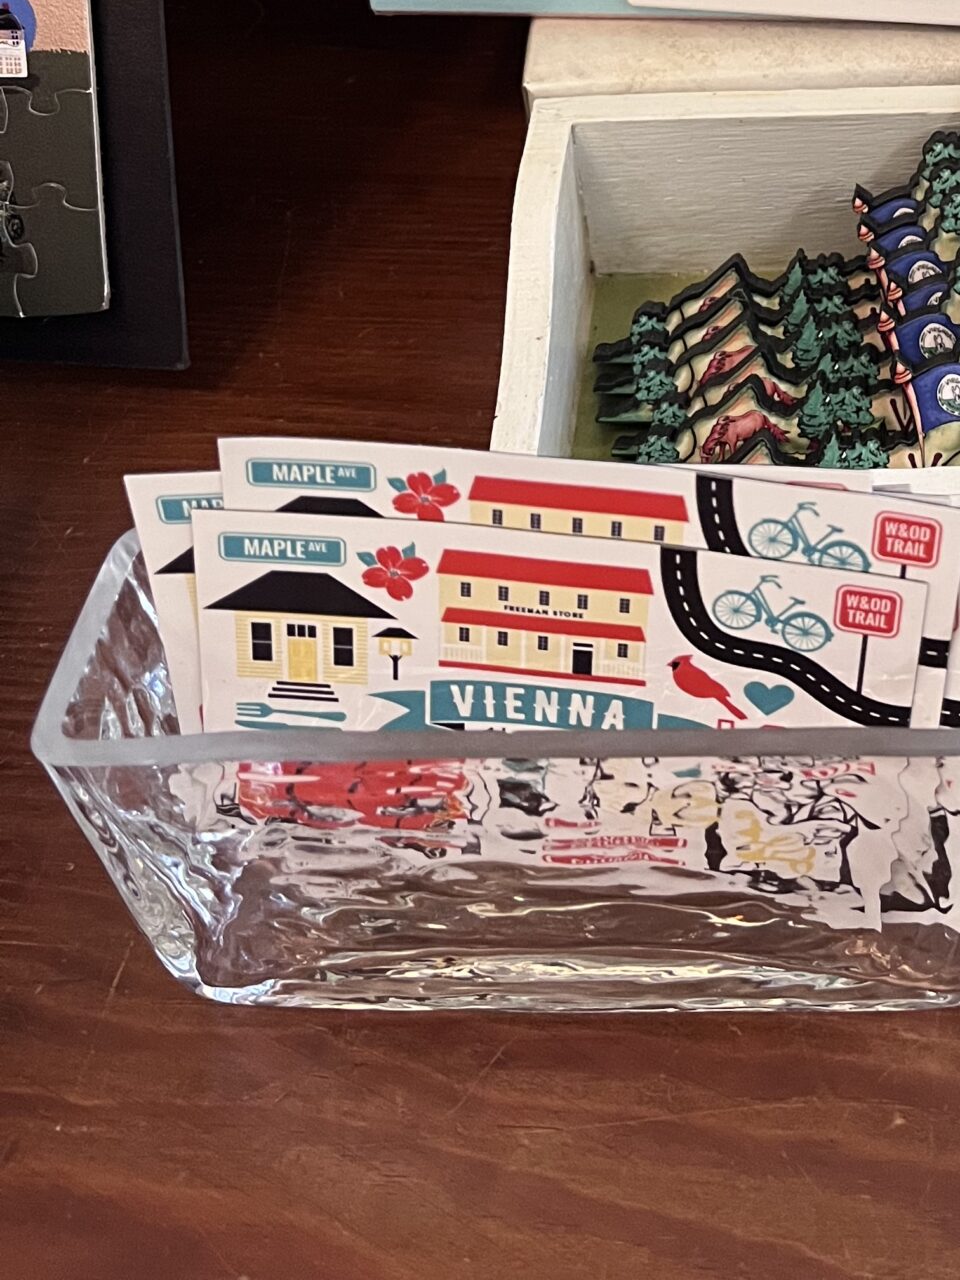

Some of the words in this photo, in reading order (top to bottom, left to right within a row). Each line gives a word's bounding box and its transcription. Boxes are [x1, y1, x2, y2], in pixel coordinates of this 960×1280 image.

[272, 463, 336, 485] MAPLE
[337, 466, 357, 480] AVE
[884, 520, 931, 542] W&OD
[243, 537, 307, 559] MAPLE
[307, 541, 328, 553] AVE
[885, 536, 927, 559] TRAIL
[503, 604, 549, 617] FREEMAN
[552, 607, 585, 620] STORE
[845, 593, 892, 614] W&OD
[847, 608, 889, 630] TRAIL
[450, 683, 626, 731] VIENNA
